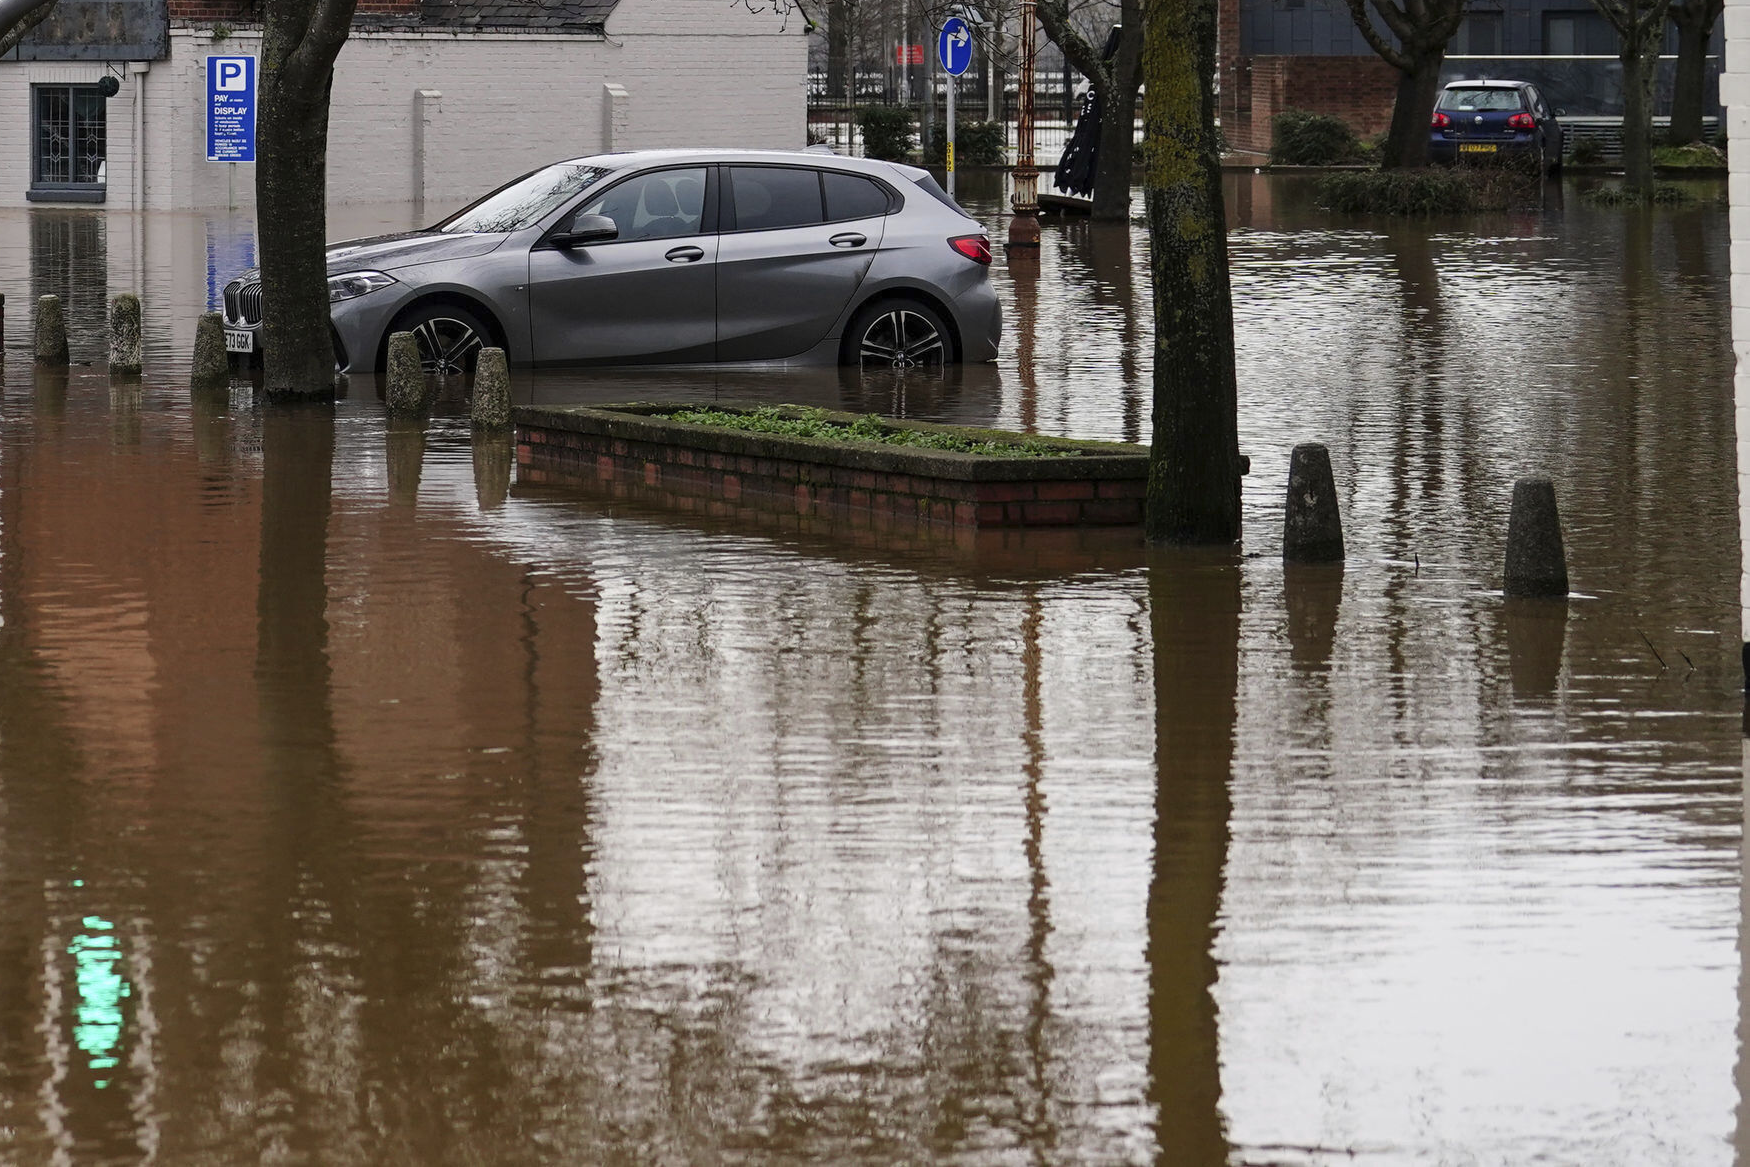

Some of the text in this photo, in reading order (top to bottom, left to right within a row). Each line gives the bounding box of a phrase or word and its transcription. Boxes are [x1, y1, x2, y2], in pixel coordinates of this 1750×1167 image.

[220, 63, 241, 87] P
[214, 94, 228, 103] PAY
[214, 107, 247, 115] DISPLAY
[237, 333, 250, 350] GGK
